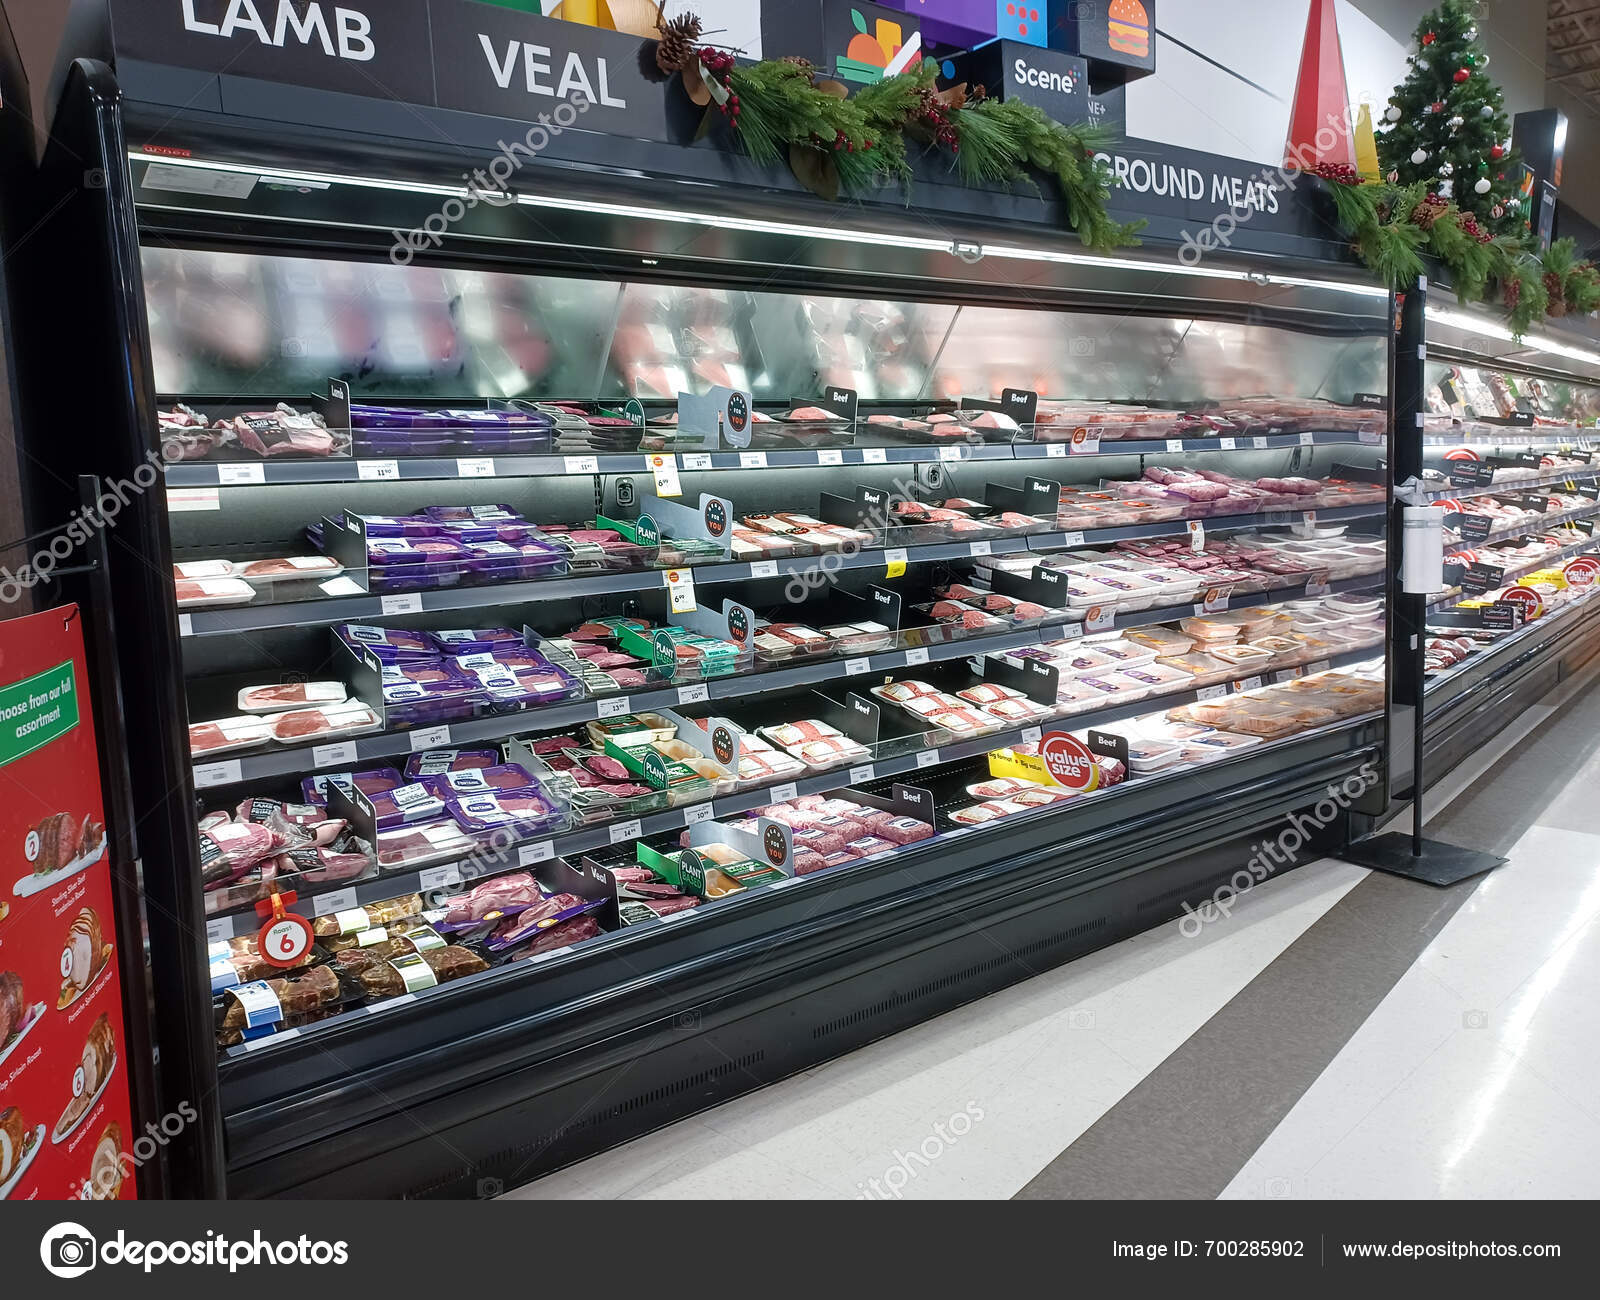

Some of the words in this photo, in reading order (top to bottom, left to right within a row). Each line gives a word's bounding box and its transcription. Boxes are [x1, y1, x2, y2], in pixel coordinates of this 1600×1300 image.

[182, 0, 376, 61] LAMB
[478, 33, 626, 109] VEAL
[1092, 152, 1206, 200] GROUND
[1211, 173, 1279, 214] MEATS
[833, 392, 849, 403] Beef
[1011, 393, 1028, 404] Beef
[1033, 481, 1051, 493] Beef
[864, 491, 880, 504] Beef
[638, 526, 657, 540] PLANT
[708, 522, 721, 531] YOU
[1041, 571, 1058, 584] Beef
[874, 590, 891, 604] Beef
[731, 626, 744, 637] YOU
[656, 642, 674, 659] PLANT
[1033, 663, 1049, 676] Beef
[0, 701, 28, 722] hoose
[29, 693, 48, 710] from
[49, 687, 60, 701] our
[61, 676, 71, 694] full
[854, 701, 870, 715] Beef
[16, 705, 61, 738] assortment
[1098, 736, 1117, 748] Beef
[716, 746, 729, 759] YOU
[1046, 749, 1090, 768] value
[1020, 760, 1028, 768] Big
[1051, 762, 1081, 777] size
[646, 762, 666, 781] PLANT
[903, 790, 921, 804] Beef
[769, 848, 782, 859] YOU
[591, 867, 607, 884] Veal
[681, 861, 702, 880] PLANT
[683, 874, 702, 890] BASED
[273, 925, 293, 936] Roast
[280, 934, 294, 954] 6
